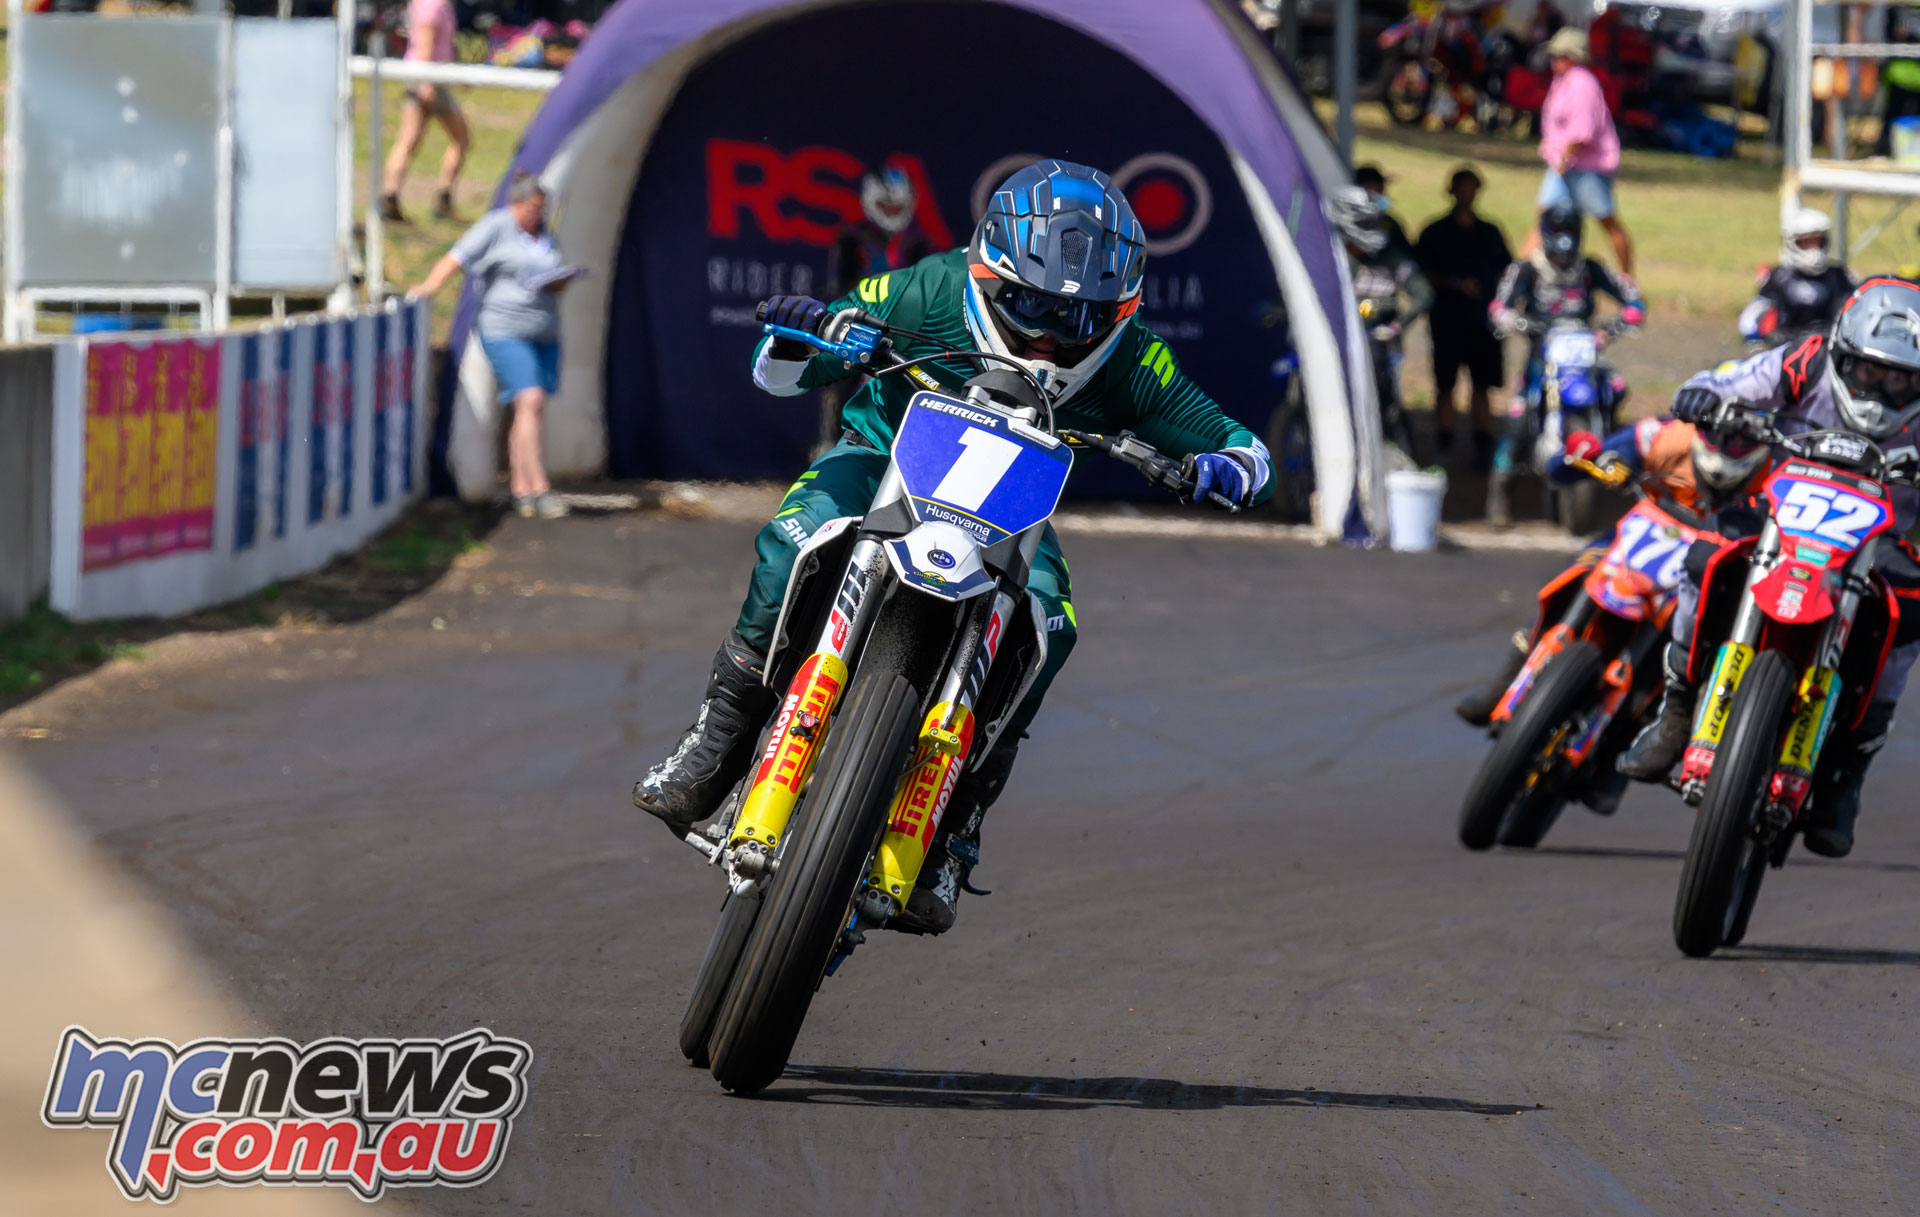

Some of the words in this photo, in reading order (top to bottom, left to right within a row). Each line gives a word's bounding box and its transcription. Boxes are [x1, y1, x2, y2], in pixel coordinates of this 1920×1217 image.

[707, 138, 955, 248] RSA
[919, 398, 999, 428] HERRICK
[931, 426, 1024, 513] 1
[780, 517, 811, 550] SH
[925, 504, 991, 537] Husqvarna
[1776, 481, 1880, 548] 52
[762, 693, 799, 763] MOTUL
[931, 756, 963, 828] MOTUL
